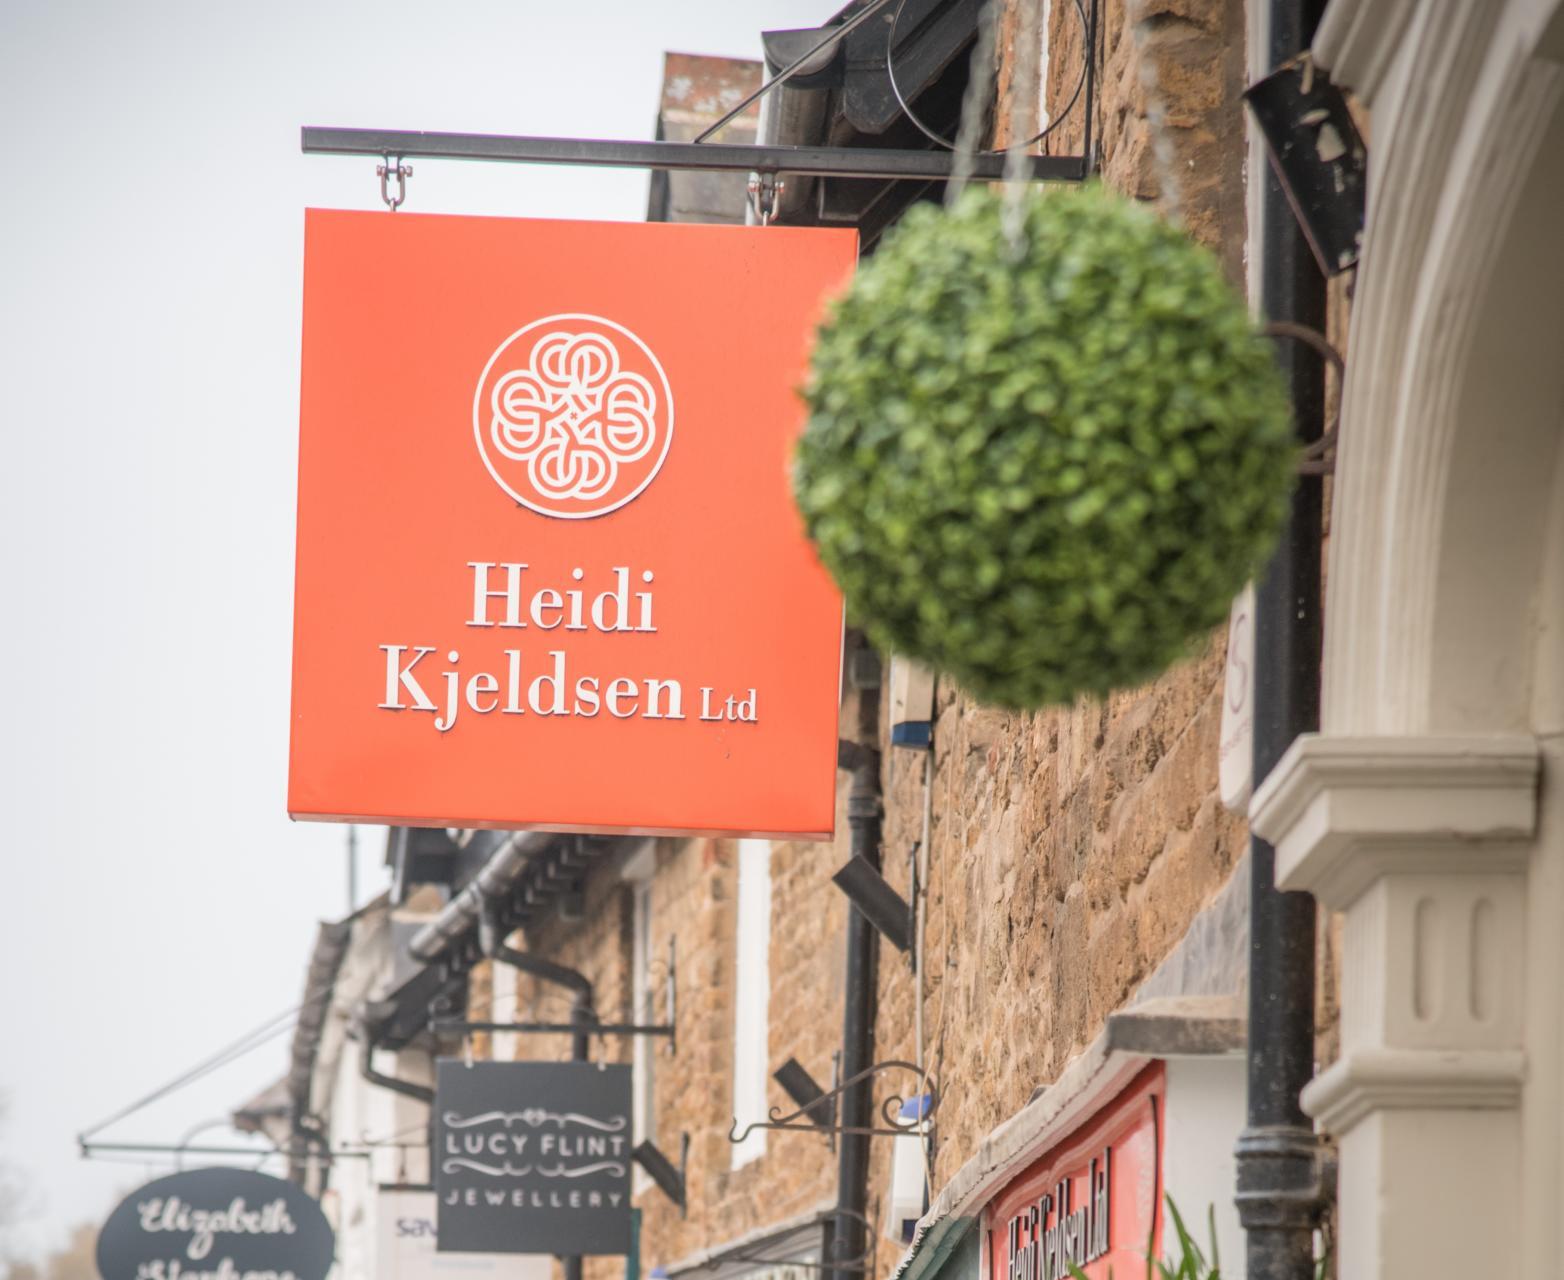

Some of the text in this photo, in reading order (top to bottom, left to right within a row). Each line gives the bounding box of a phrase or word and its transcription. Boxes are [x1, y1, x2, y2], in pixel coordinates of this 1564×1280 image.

[465, 561, 658, 632] Heidi
[377, 644, 759, 731] Kjeldsen Ltd
[445, 1132, 625, 1157] LUCY FLINT
[137, 1195, 297, 1260] Elizabeth
[445, 1187, 622, 1209] JEWELLERY
[1087, 1147, 1111, 1262] Ltd
